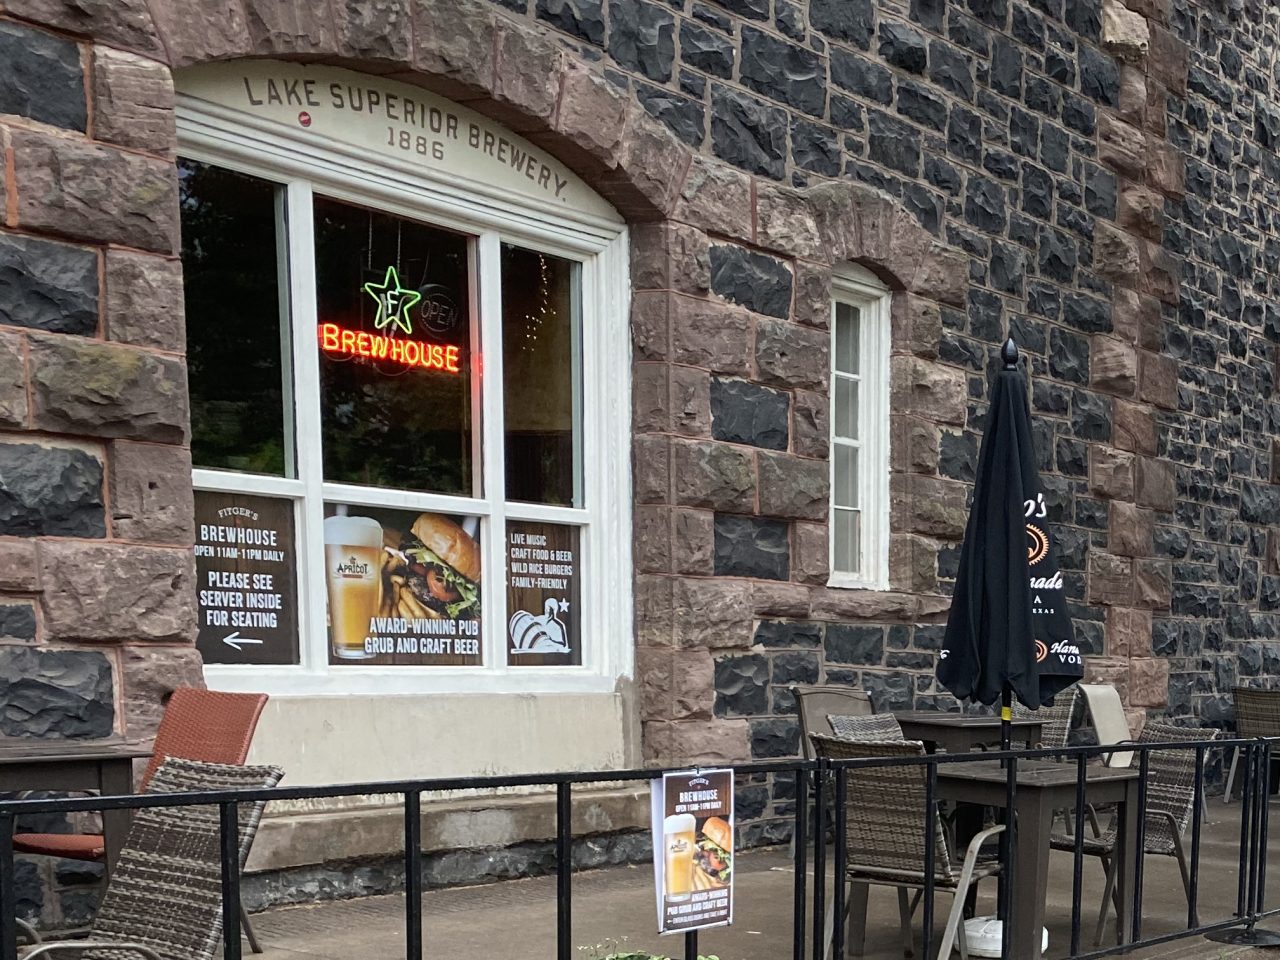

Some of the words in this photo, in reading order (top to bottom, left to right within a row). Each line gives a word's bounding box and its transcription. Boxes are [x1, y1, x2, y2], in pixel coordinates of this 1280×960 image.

[243, 76, 321, 107] LAKE
[330, 83, 459, 141] SUPERIOR
[386, 127, 445, 161] 1886
[421, 300, 458, 328] OPEN
[322, 323, 460, 372] BREWHOUSE
[218, 507, 258, 521] FITGER'S
[200, 524, 277, 546] BREWHOUSE
[510, 533, 525, 544] LIVE
[526, 534, 547, 546] MUSIC
[194, 545, 214, 557] OPEN
[263, 550, 284, 562] DAILY
[511, 548, 531, 559] CRAFT
[532, 549, 549, 560] FOOD
[550, 551, 555, 561] &
[555, 551, 572, 562] BEER
[511, 562, 528, 574] WILD
[528, 563, 544, 575] RICE
[544, 564, 572, 576] BURGERS
[208, 571, 250, 589] PLEASE
[252, 573, 273, 590] SEE
[511, 577, 568, 590] FAMILY-FRIENDLY
[200, 591, 243, 608] SERVER
[246, 592, 282, 609] INSIDE
[206, 610, 228, 626] FOR
[231, 611, 278, 628] SEATING
[369, 617, 456, 635] AWARD-WINNING
[458, 619, 479, 636] PUB
[364, 637, 394, 654] GRUB
[396, 637, 418, 654] AND
[419, 638, 451, 654] CRAFT
[454, 639, 479, 655] BEER
[679, 789, 718, 803] BREWHOUSE
